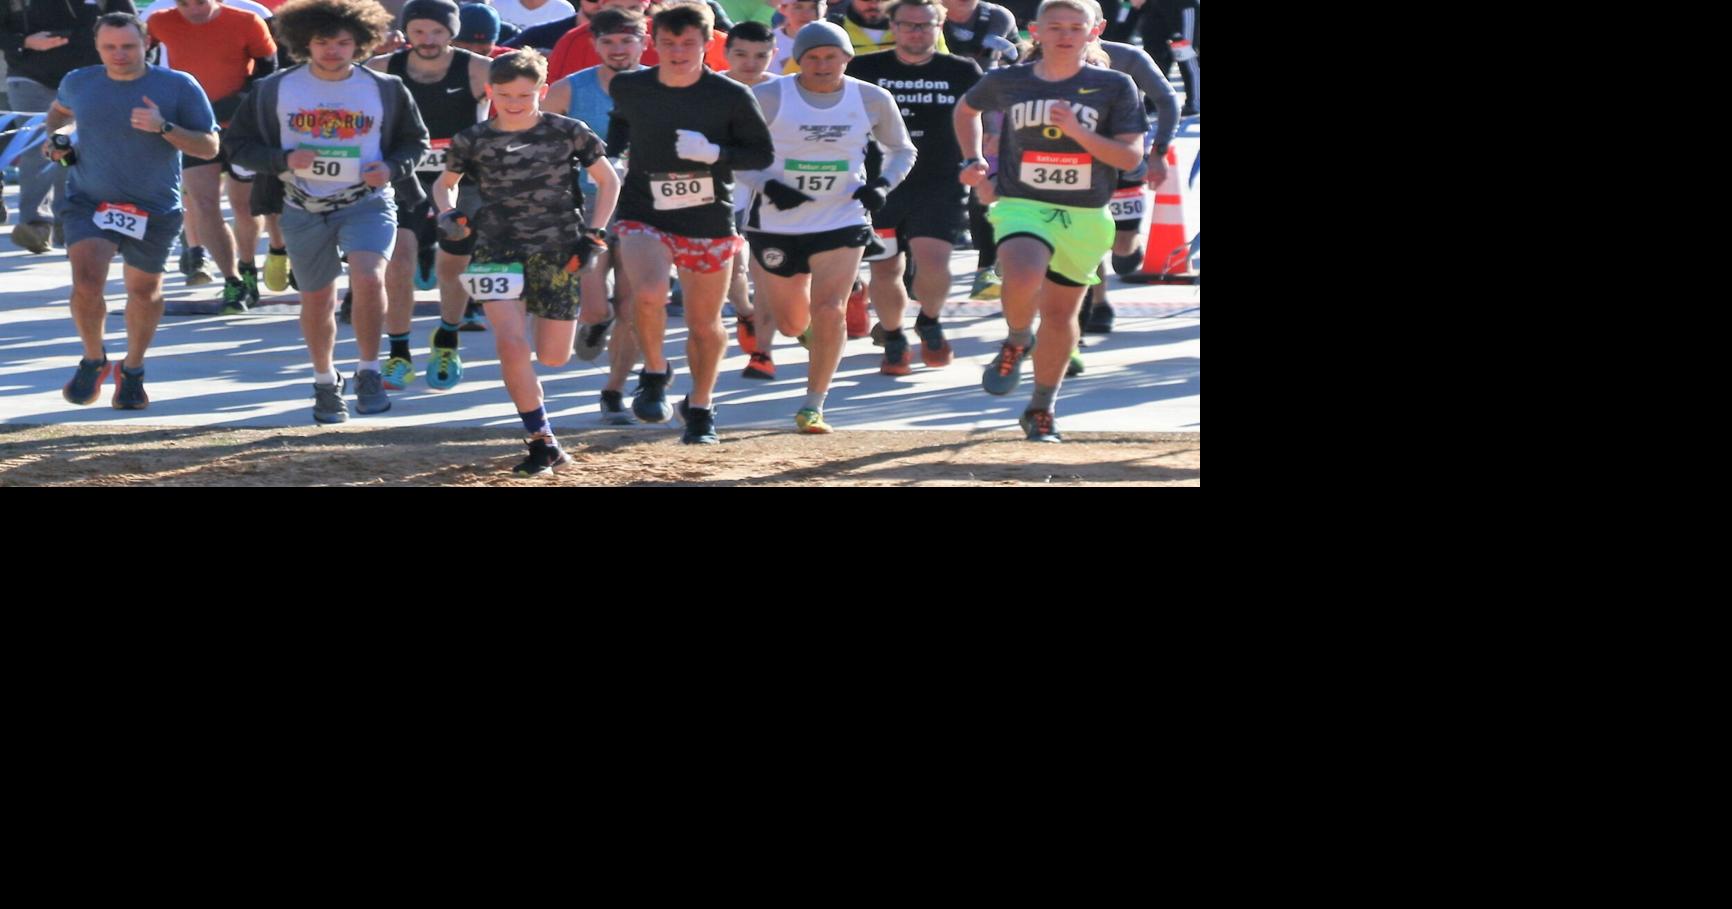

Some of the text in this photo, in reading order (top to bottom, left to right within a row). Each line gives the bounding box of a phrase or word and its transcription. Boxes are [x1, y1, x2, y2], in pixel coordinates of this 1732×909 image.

[878, 79, 949, 90] Freedom
[894, 93, 955, 104] ould be
[344, 113, 374, 129] RUN
[311, 160, 341, 177] 50
[1033, 168, 1079, 184] 348
[661, 180, 701, 197] 680
[795, 175, 837, 191] 157
[1110, 200, 1143, 215] 350
[103, 211, 137, 232] 332
[468, 277, 509, 294] 193
